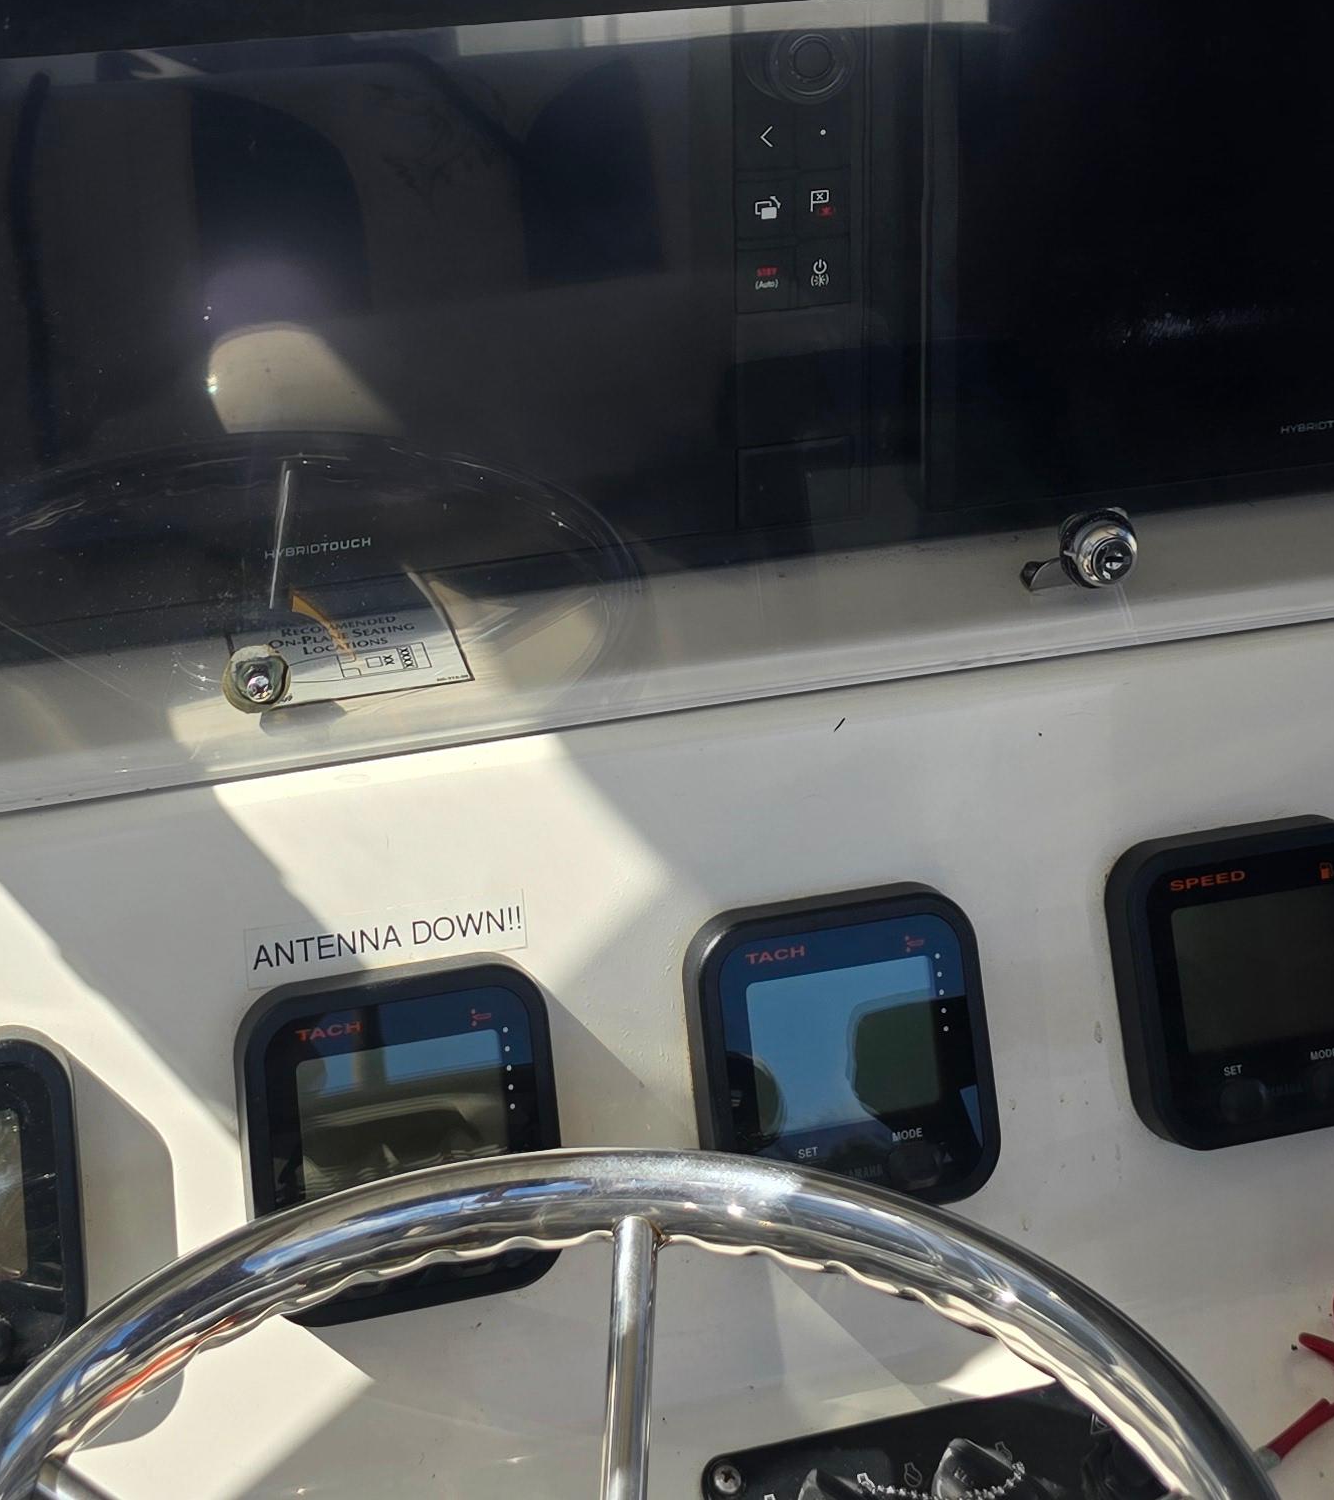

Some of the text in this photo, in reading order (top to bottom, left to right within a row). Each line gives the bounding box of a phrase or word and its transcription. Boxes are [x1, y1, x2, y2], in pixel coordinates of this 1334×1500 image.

[264, 536, 372, 560] HYBRIDTOUCH
[352, 621, 416, 638] SEATING
[1170, 869, 1246, 892] SPEED
[252, 904, 523, 971] ANTENNA DOWN!!
[745, 944, 806, 966] TACH
[295, 1019, 364, 1042] TACH
[1223, 1063, 1243, 1077] SET
[891, 1126, 924, 1142] MODE
[798, 1145, 819, 1160] SET
